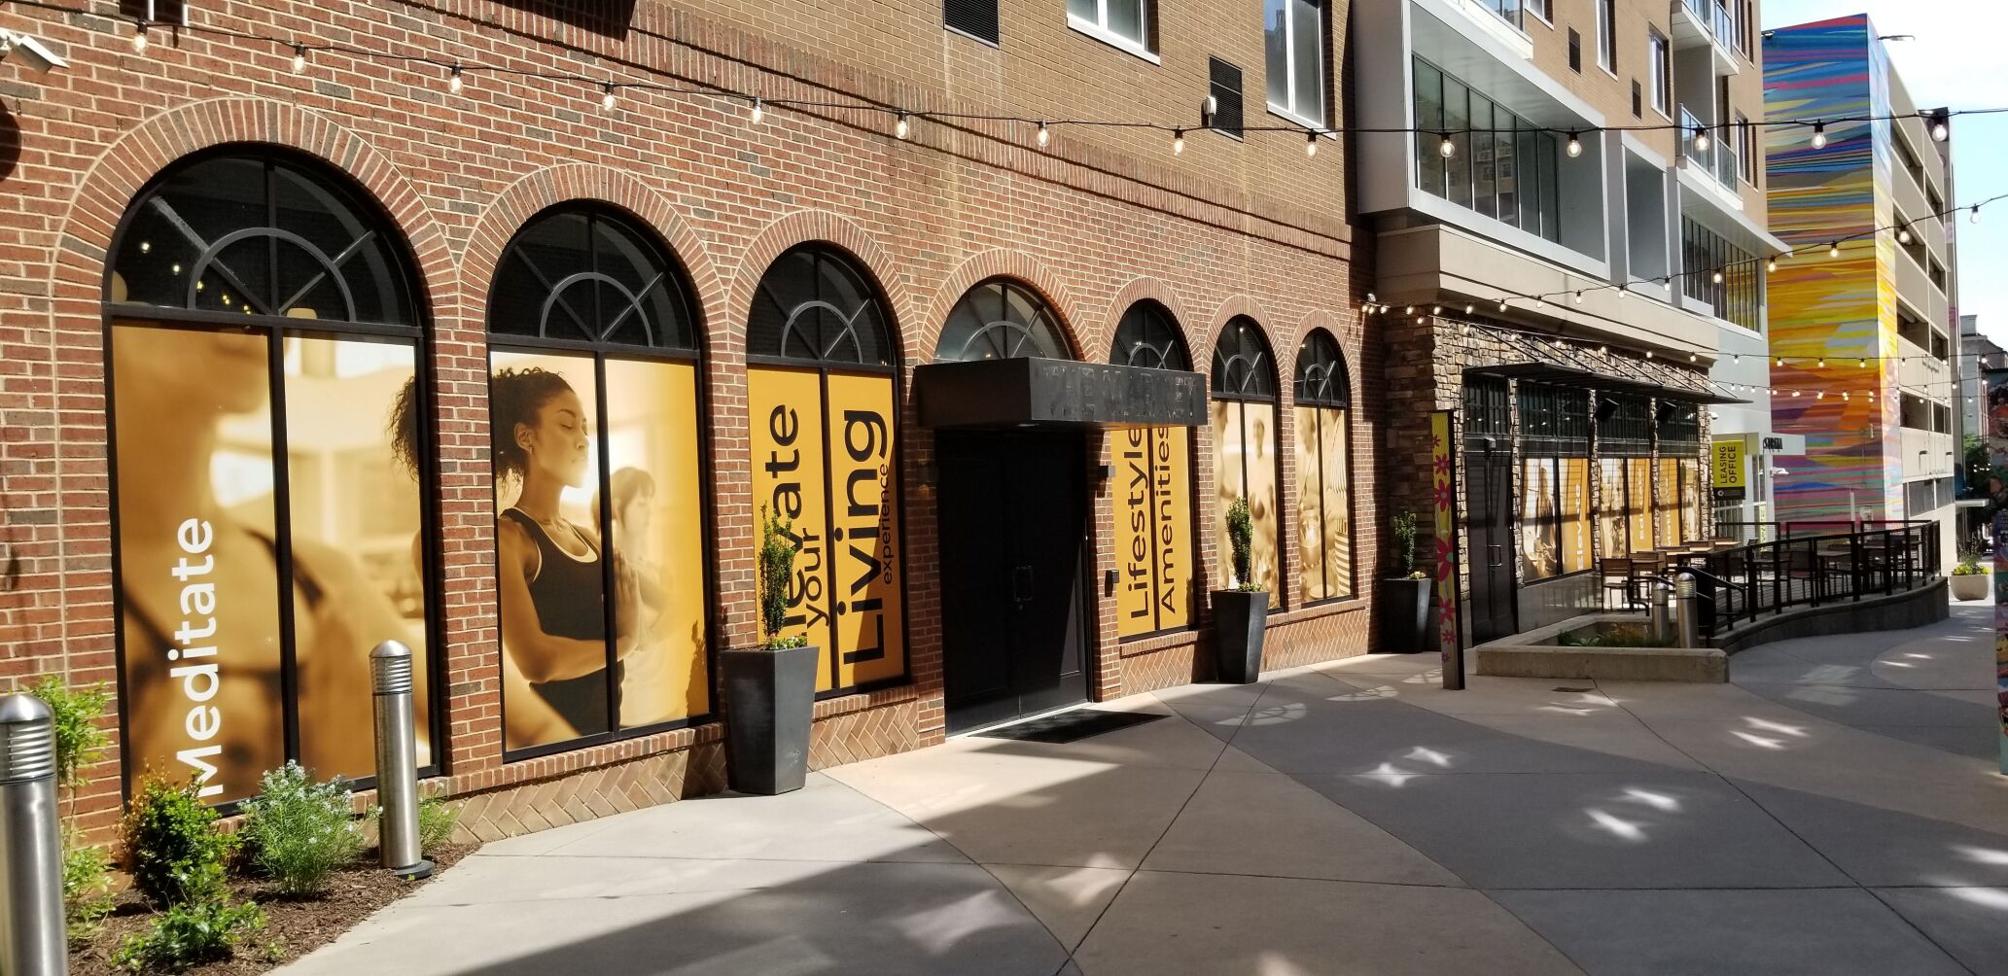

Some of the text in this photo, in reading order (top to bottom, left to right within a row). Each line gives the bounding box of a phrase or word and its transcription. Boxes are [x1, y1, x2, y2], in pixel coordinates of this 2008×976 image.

[833, 409, 887, 665] Living
[878, 463, 893, 585] experience
[1123, 429, 1149, 619] Lifestyle
[1155, 427, 1176, 614] Amenities
[1719, 446, 1727, 484] LEASING
[1728, 446, 1737, 484] OFFICE
[802, 528, 829, 629] your
[167, 517, 224, 799] Meditate
